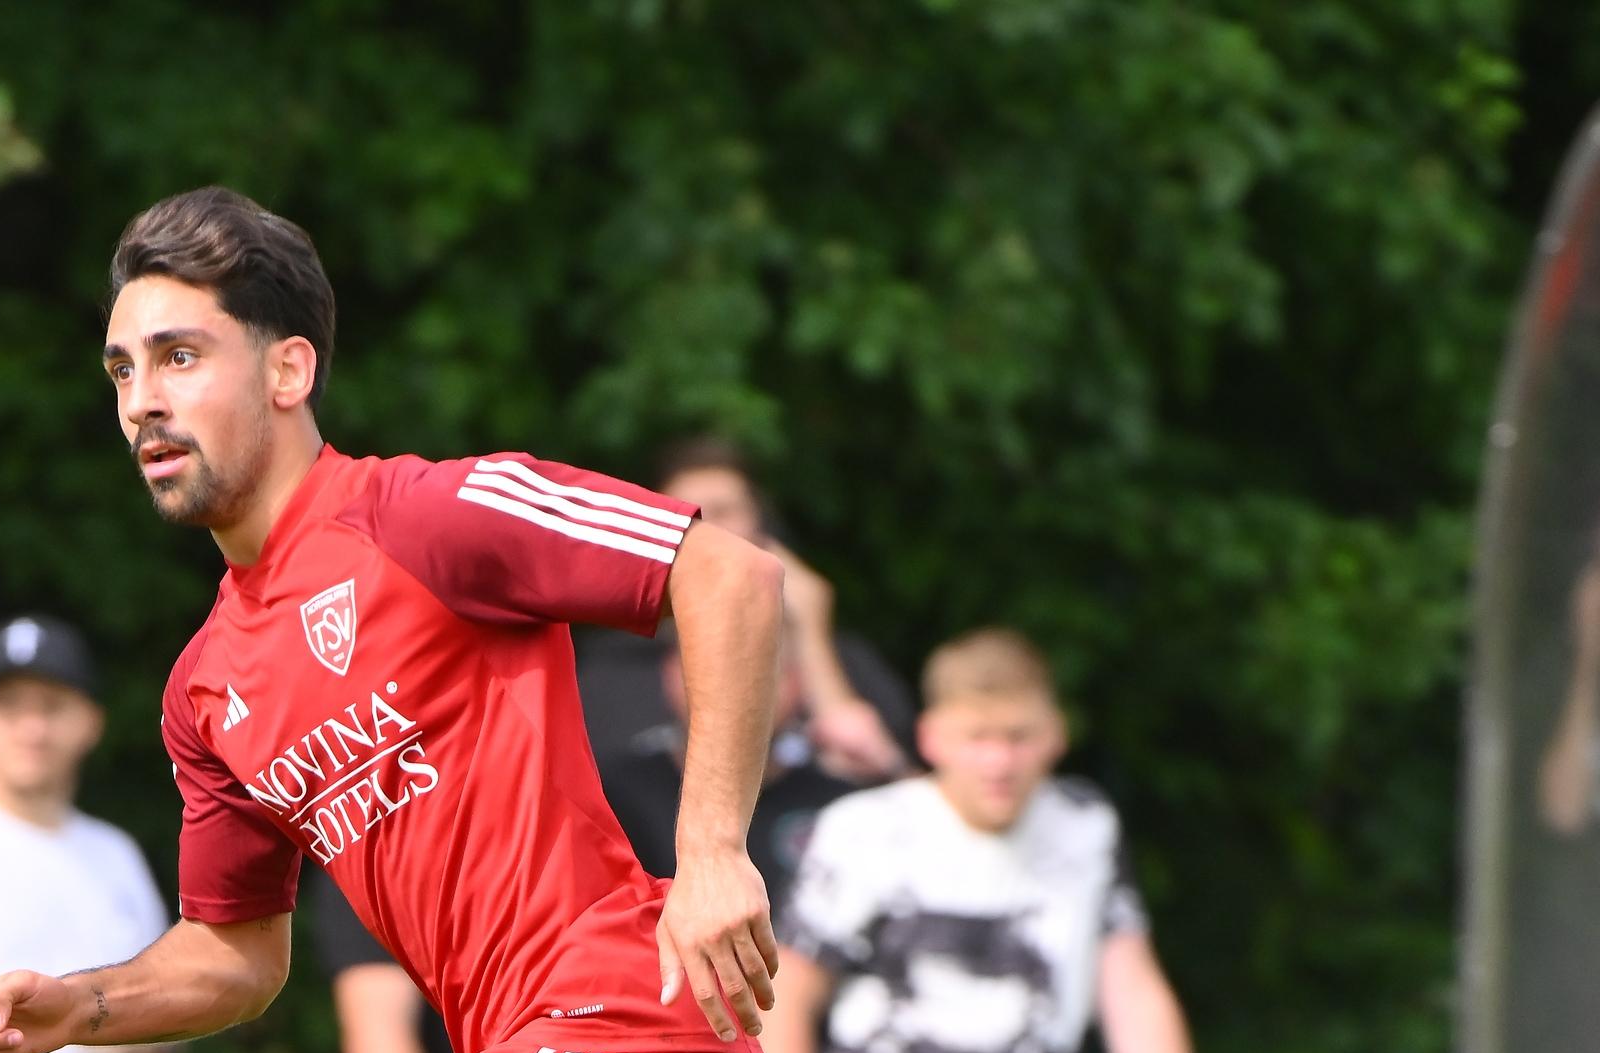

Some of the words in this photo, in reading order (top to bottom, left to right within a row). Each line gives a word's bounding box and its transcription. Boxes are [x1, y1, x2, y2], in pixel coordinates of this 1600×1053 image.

[312, 606, 351, 655] TSV
[245, 691, 417, 816] NOVINA
[299, 741, 440, 866] HOTELS
